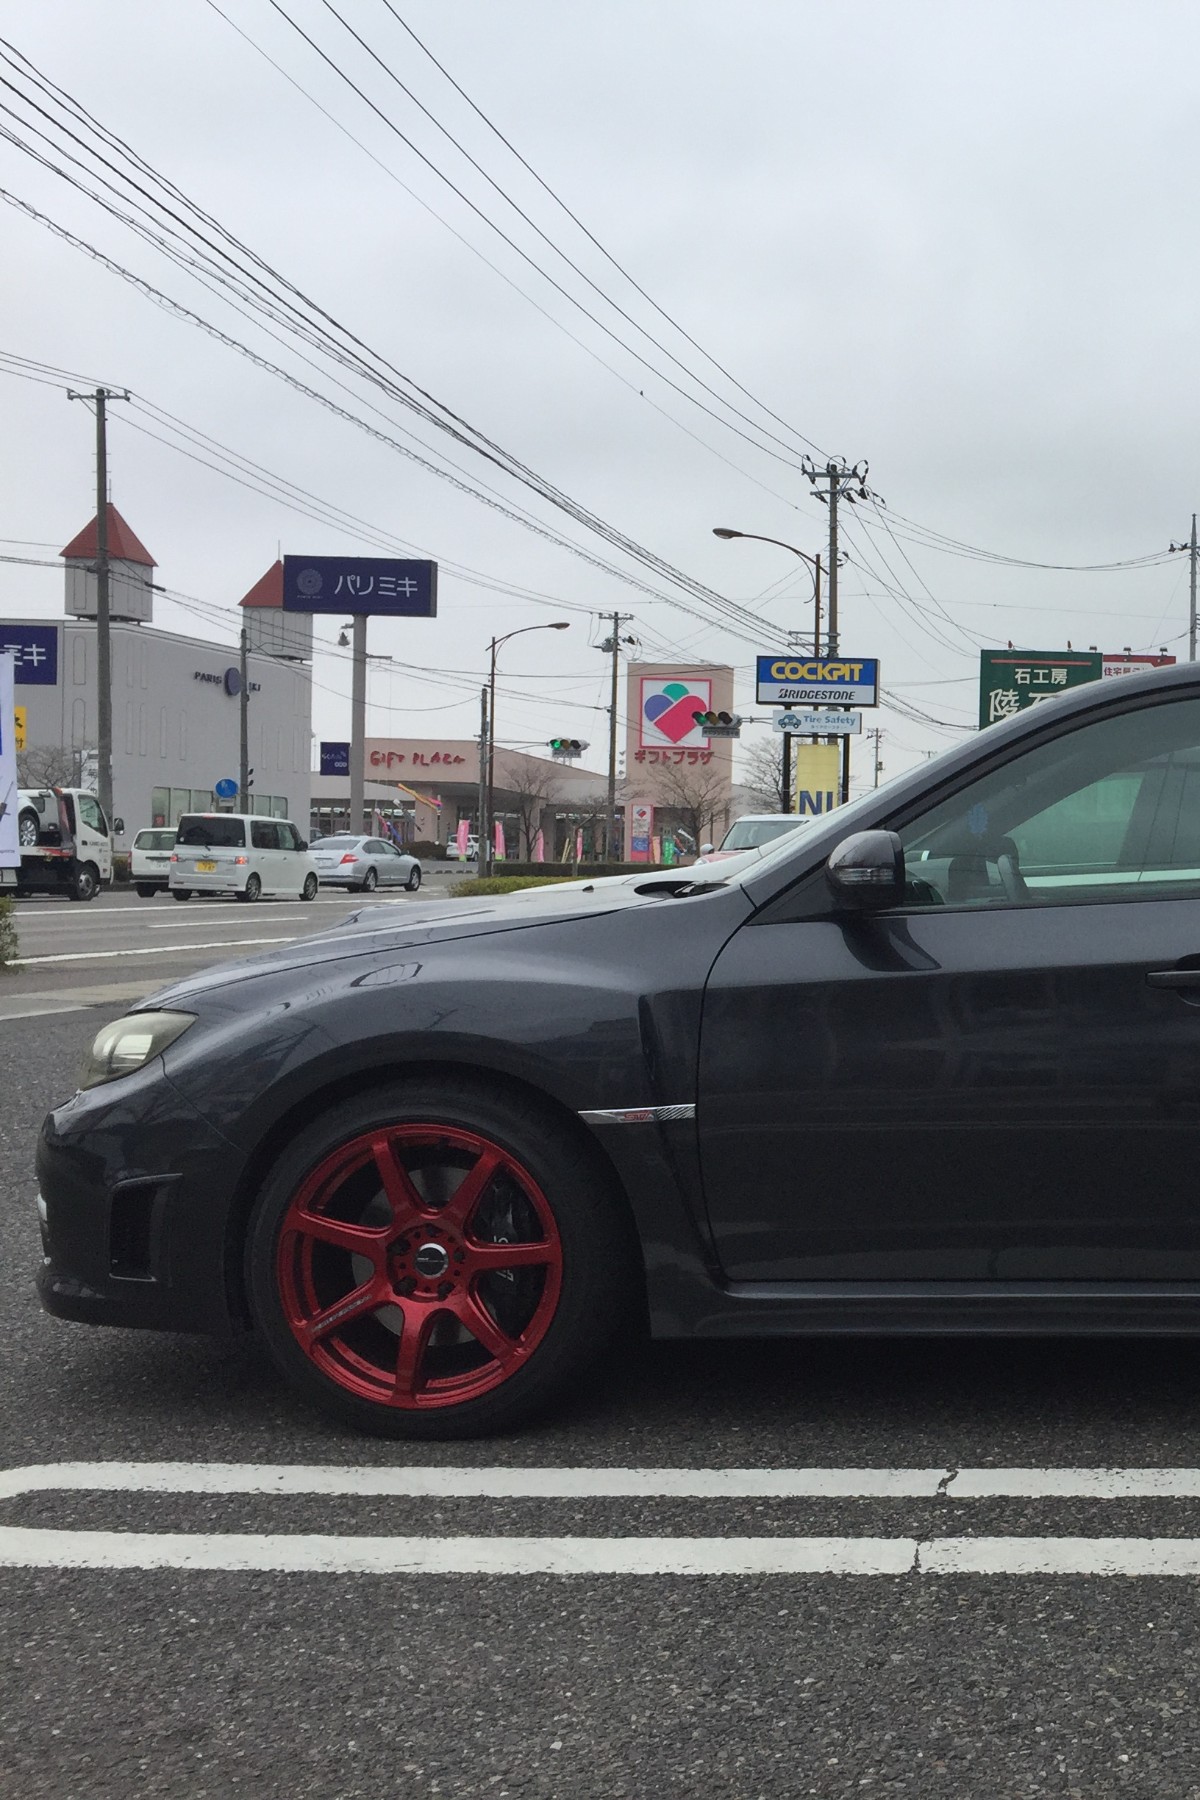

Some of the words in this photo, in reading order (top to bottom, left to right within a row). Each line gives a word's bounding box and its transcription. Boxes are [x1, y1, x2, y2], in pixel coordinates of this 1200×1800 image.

[334, 574, 419, 598] パリミキ
[194, 671, 223, 685] PARIS
[771, 661, 863, 682] COCKPIT
[1014, 668, 1068, 685] 石工房
[778, 688, 856, 701] BRIDGESTONE
[803, 714, 823, 724] Tire
[825, 715, 856, 727] Safety
[634, 749, 715, 765] ギフトプラザ
